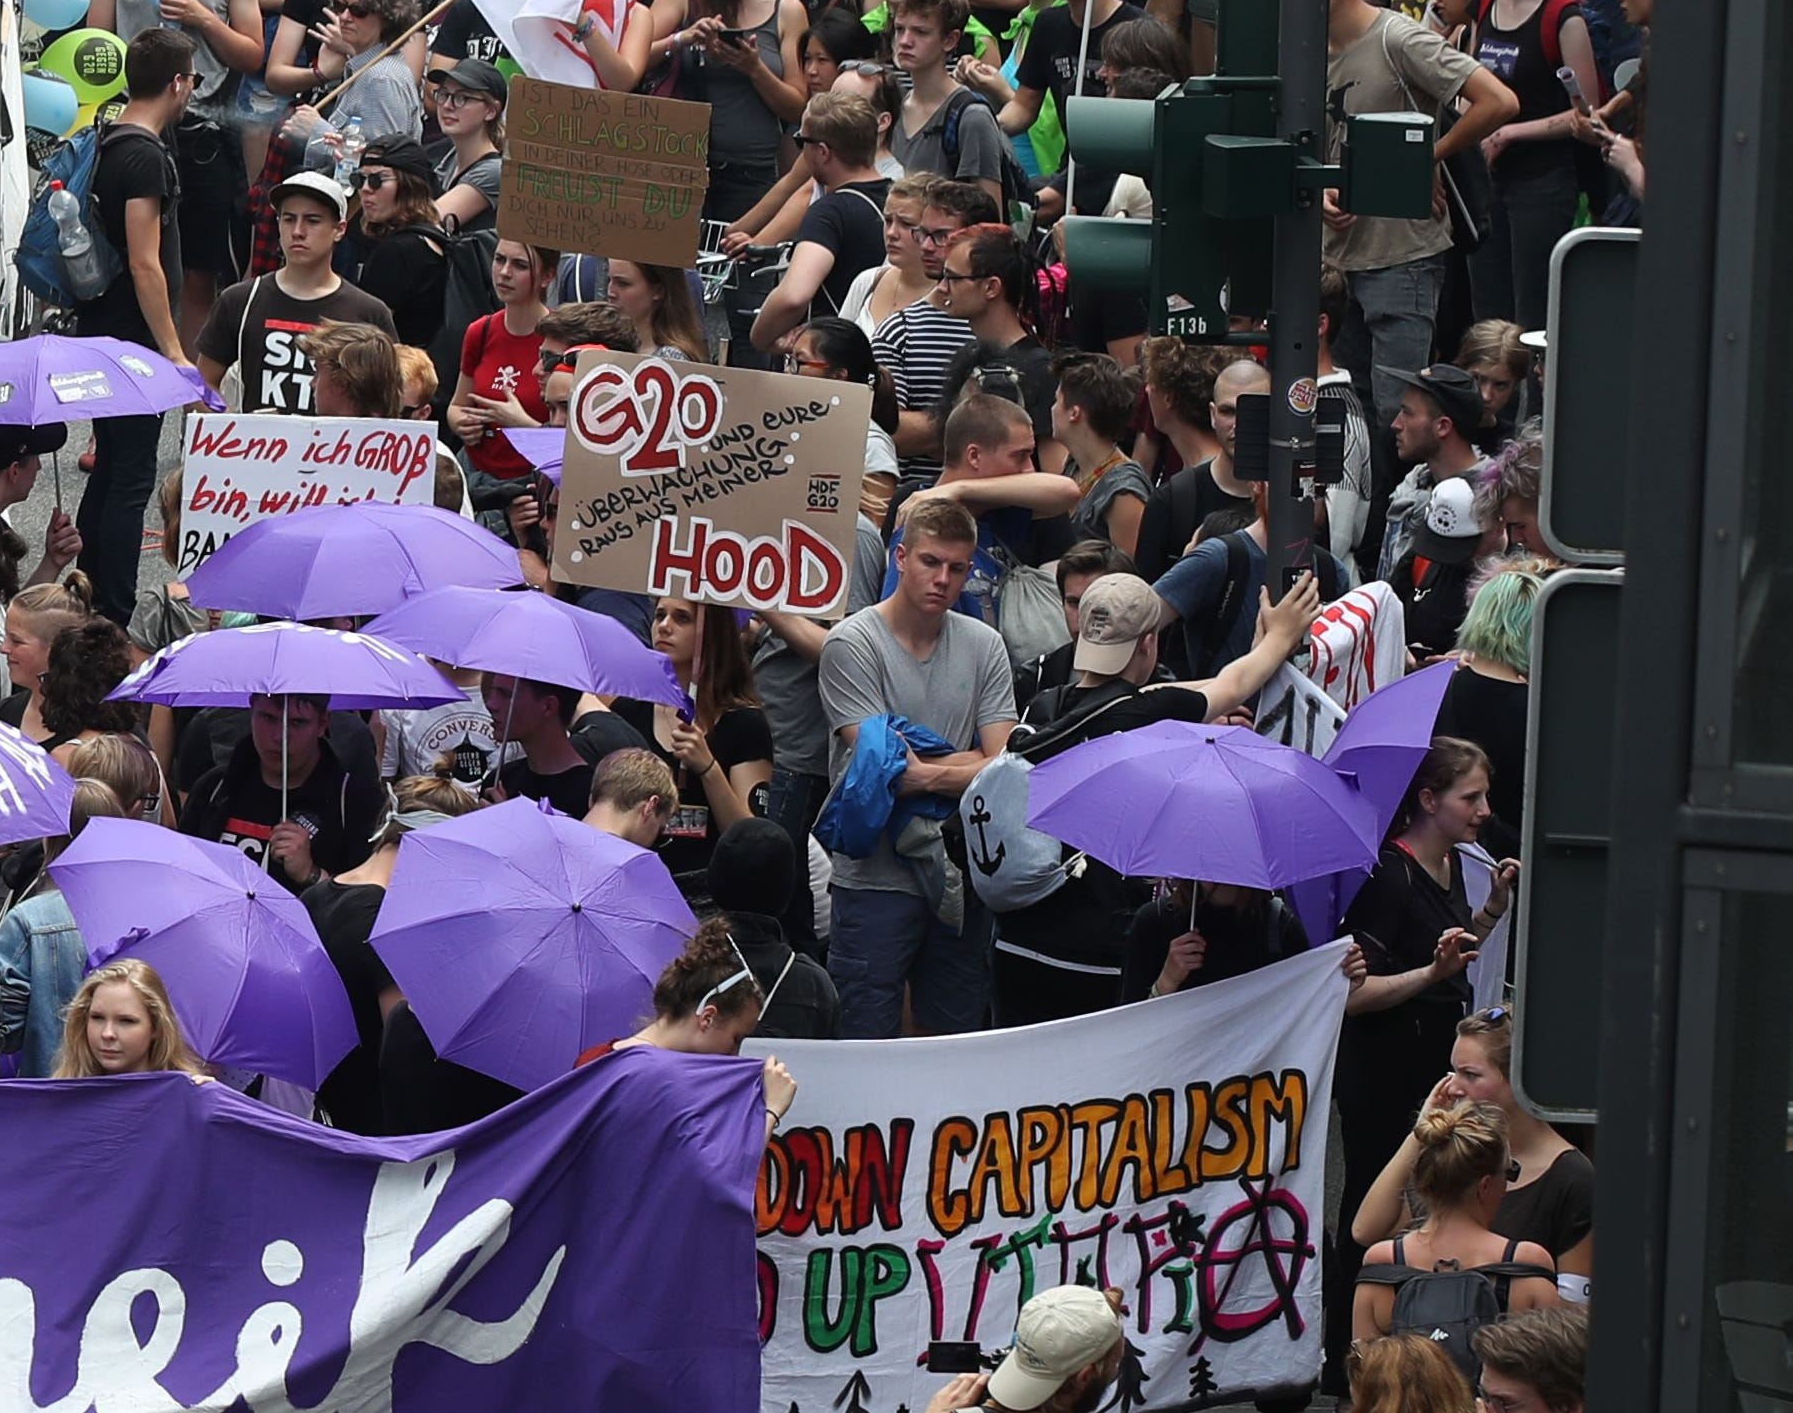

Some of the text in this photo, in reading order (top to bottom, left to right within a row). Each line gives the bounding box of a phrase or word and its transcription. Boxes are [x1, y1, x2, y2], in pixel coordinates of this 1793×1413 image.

[95, 46, 107, 74] GEGEN
[103, 41, 118, 75] JUGEND
[521, 81, 660, 122] IST DAS EIN
[522, 108, 709, 159] SCHLAGSTOCK
[545, 147, 606, 170] DEINER
[508, 195, 548, 216] DICH
[556, 204, 593, 222] NUR
[516, 163, 692, 221] FREUST DU
[523, 216, 602, 252] SEHEN?
[1166, 317, 1208, 336] F13b
[572, 360, 722, 474] G20
[709, 423, 755, 452] UND
[189, 418, 285, 463] Wenn
[300, 429, 351, 465] ich
[188, 476, 250, 524] bin,
[806, 494, 840, 510] G20
[807, 480, 841, 495] HDF
[578, 521, 634, 558] RAUS
[636, 497, 679, 530] AUS
[649, 516, 846, 611] HOOD
[926, 1066, 1310, 1239] CAPITALISM
[800, 1244, 915, 1358] UP
